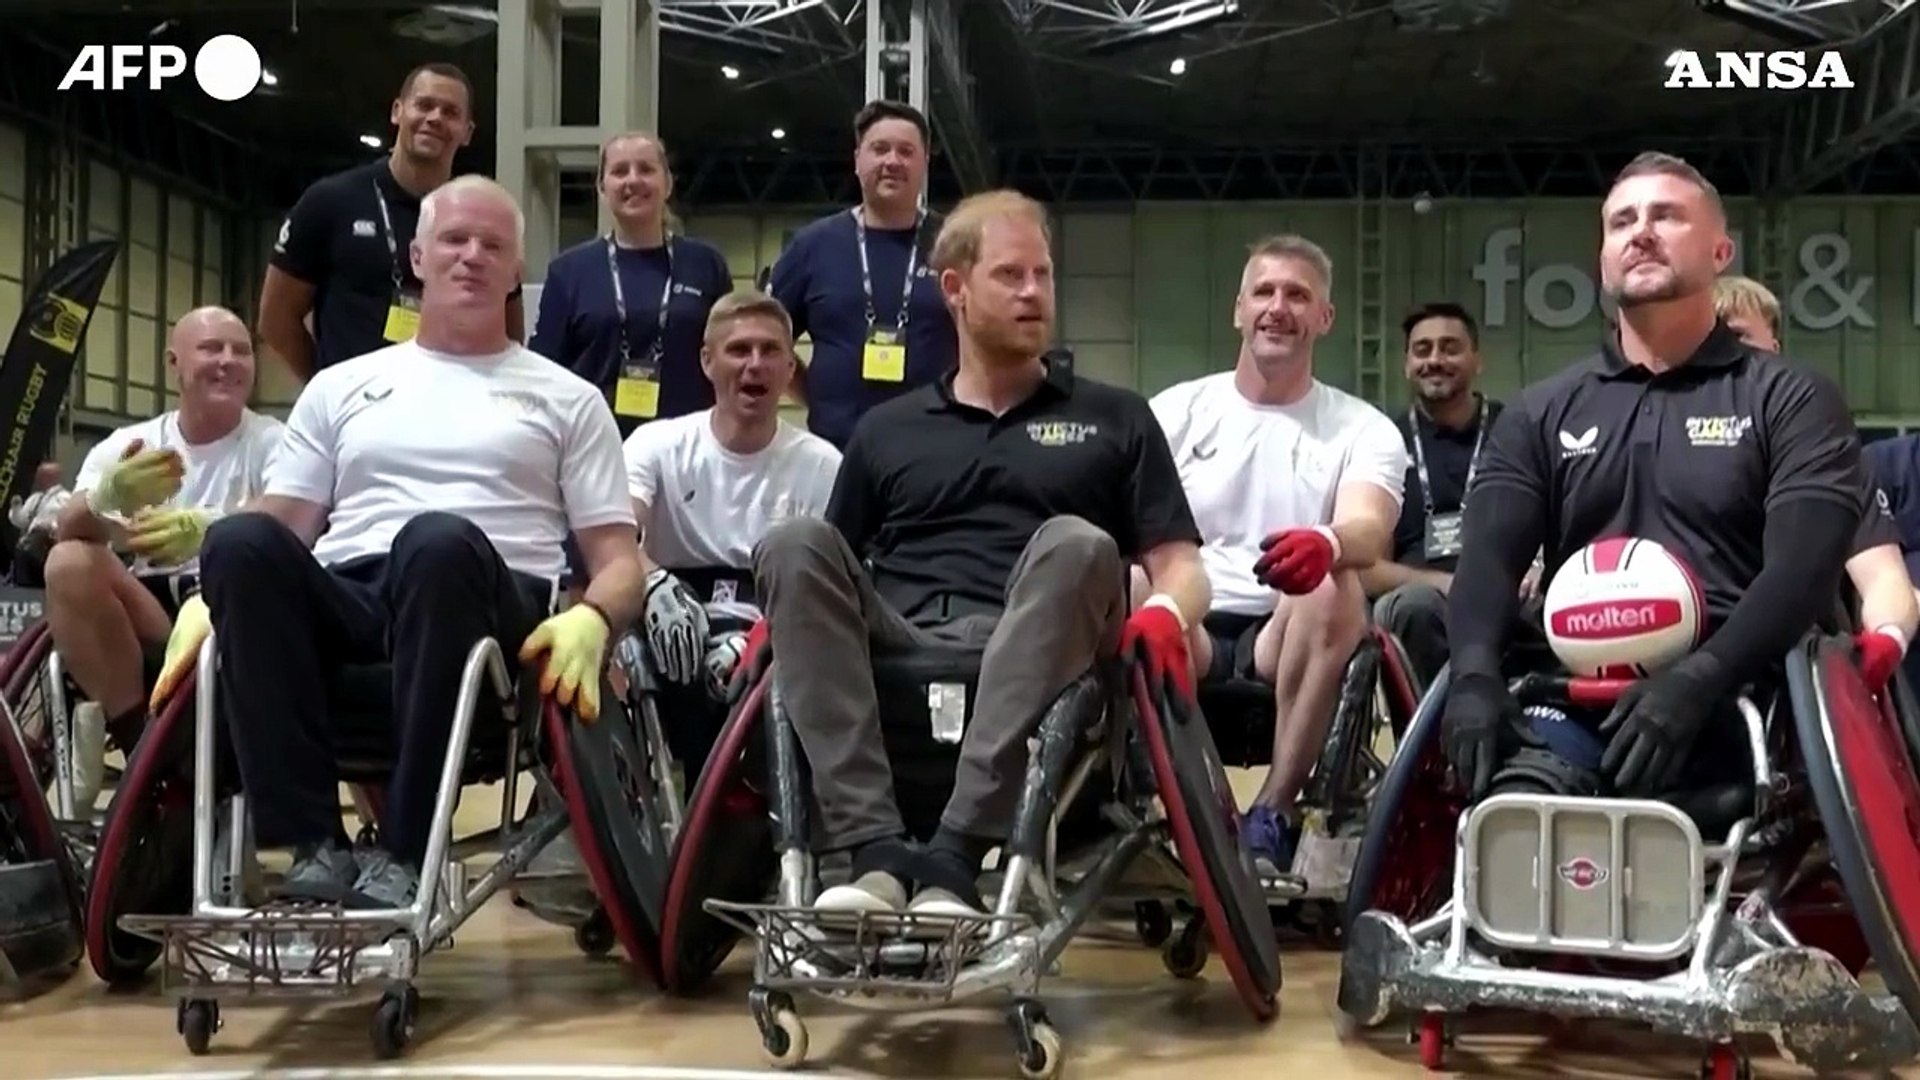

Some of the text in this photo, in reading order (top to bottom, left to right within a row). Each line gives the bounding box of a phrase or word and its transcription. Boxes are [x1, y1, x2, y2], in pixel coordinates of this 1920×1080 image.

[1789, 233, 1875, 330] &
[0, 362, 47, 509] LCHAIR RUGBY
[1566, 606, 1656, 633] molten
